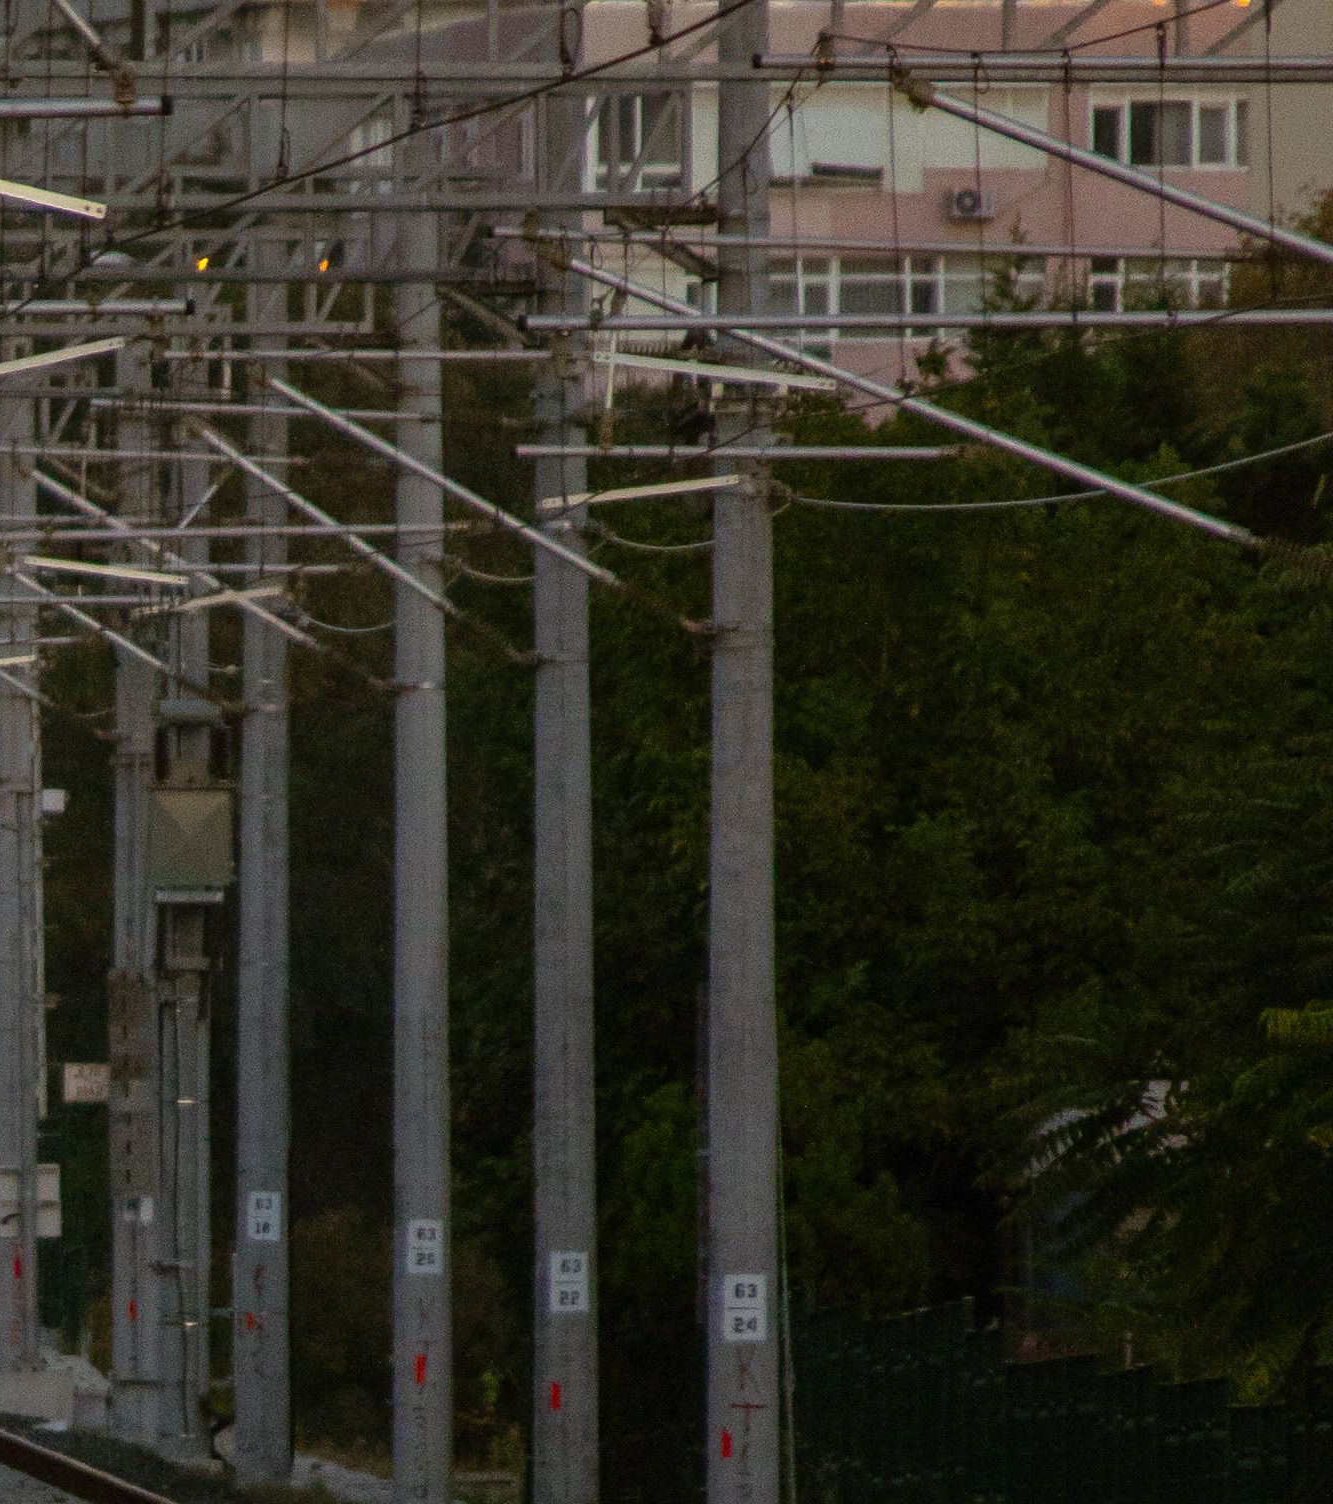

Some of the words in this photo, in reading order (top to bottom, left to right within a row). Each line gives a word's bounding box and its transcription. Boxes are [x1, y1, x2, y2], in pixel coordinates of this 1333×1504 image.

[255, 1197, 273, 1210] 63
[416, 1227, 437, 1241] 63
[560, 1259, 583, 1273] 63
[734, 1282, 758, 1298] 63
[559, 1290, 580, 1306] 22
[733, 1317, 758, 1333] 24
